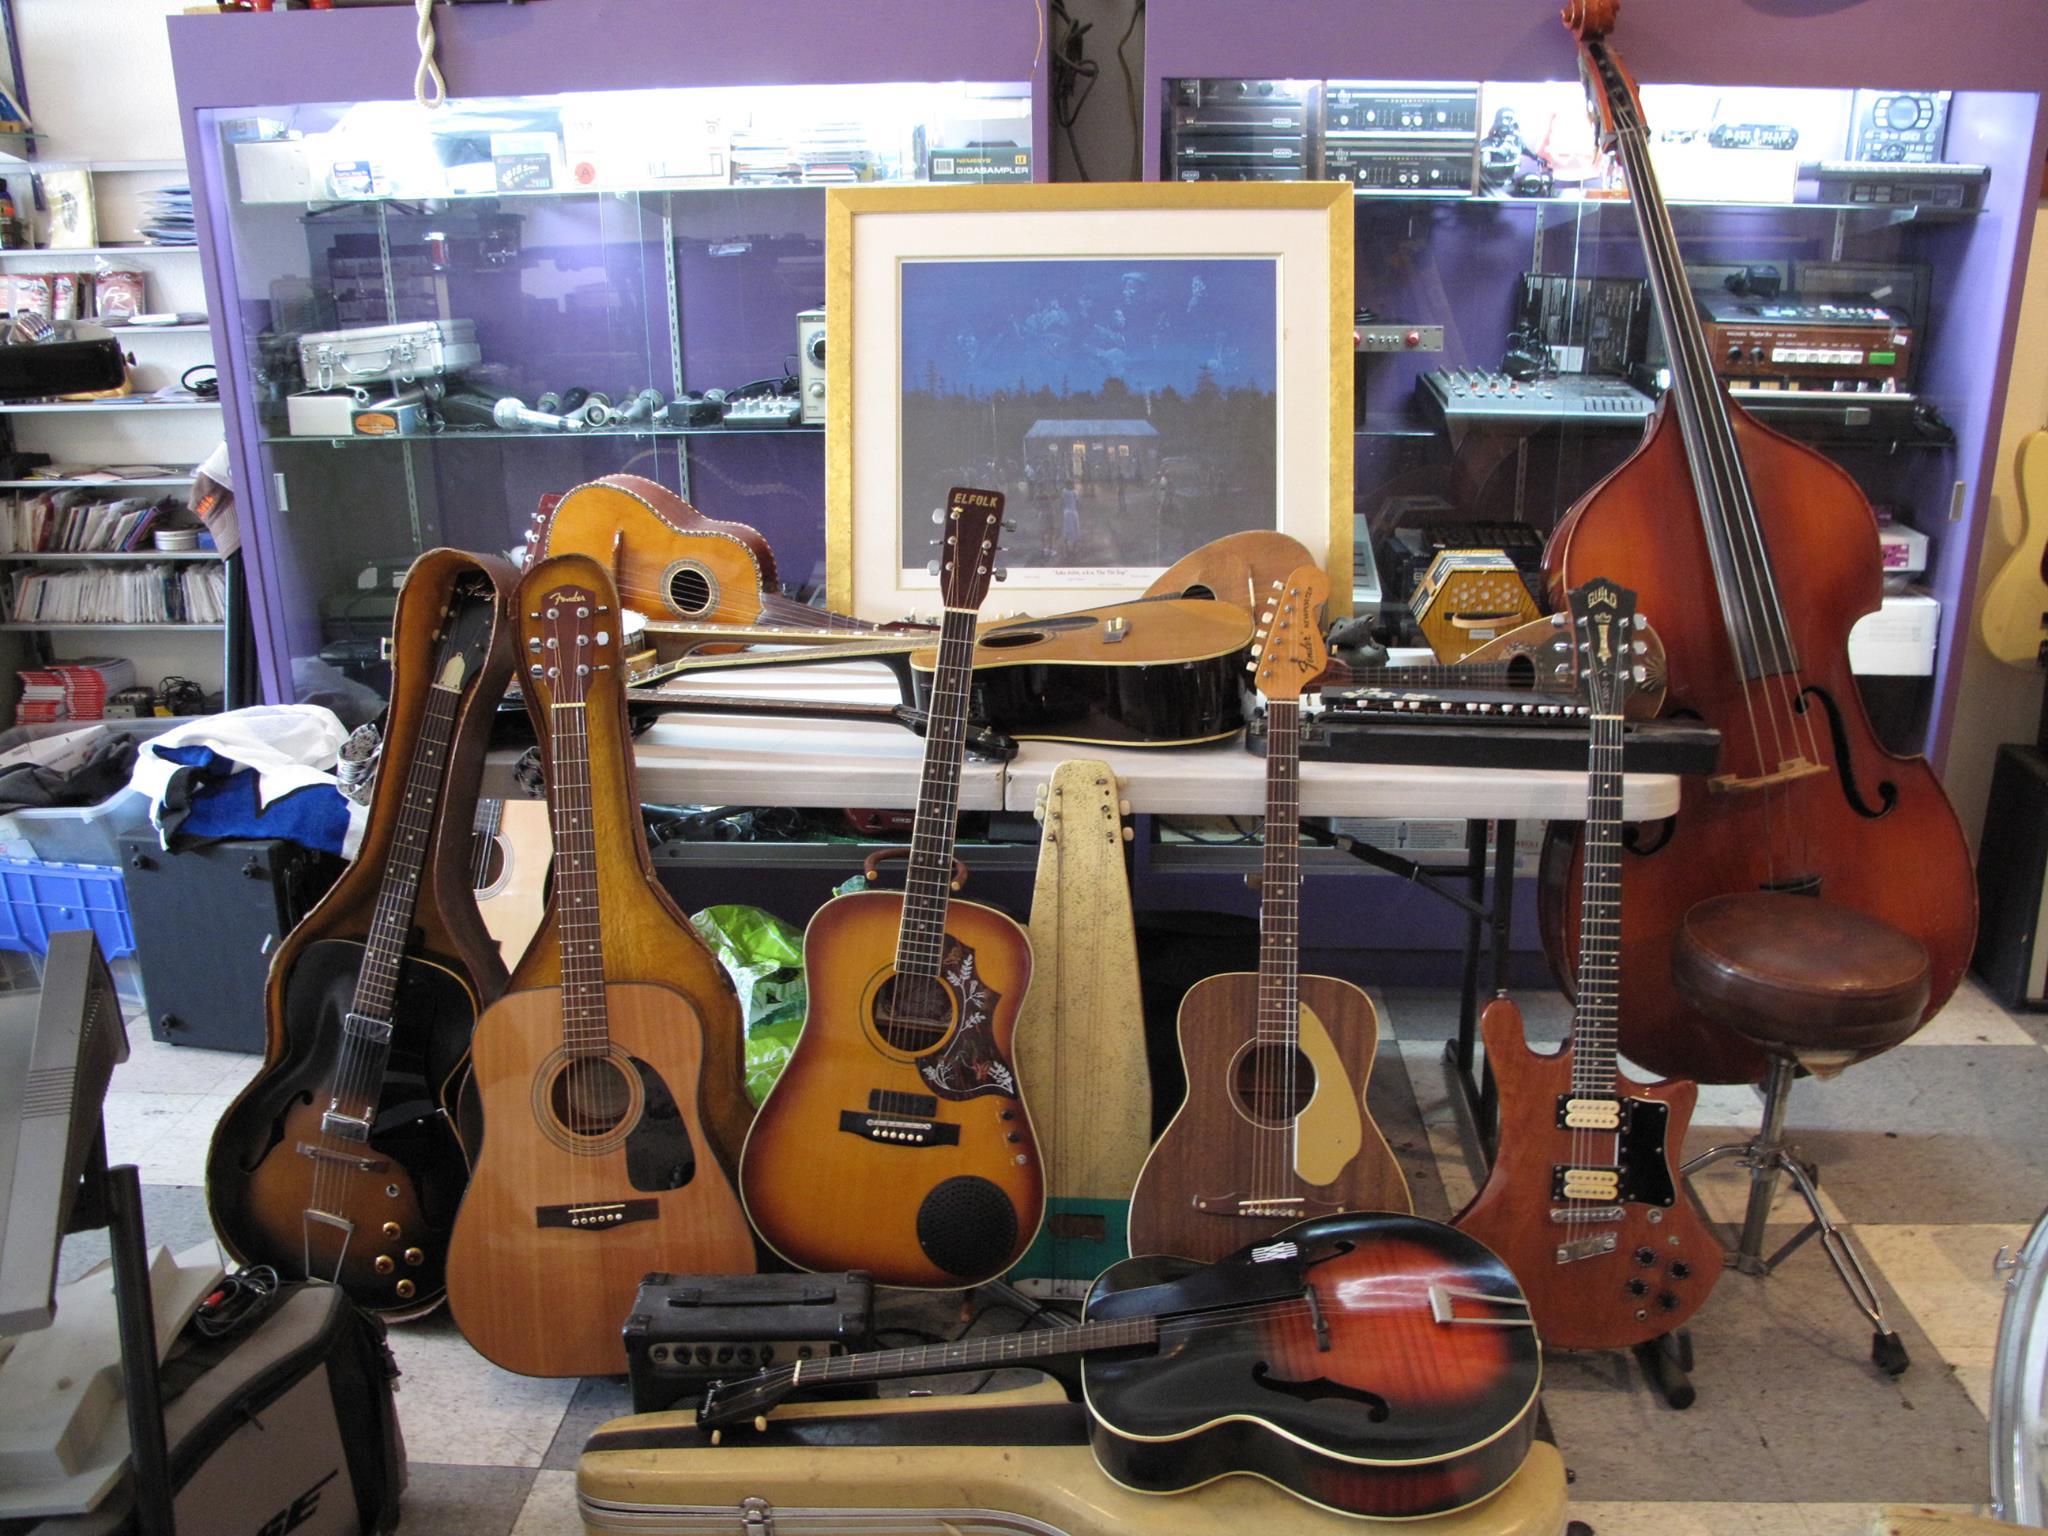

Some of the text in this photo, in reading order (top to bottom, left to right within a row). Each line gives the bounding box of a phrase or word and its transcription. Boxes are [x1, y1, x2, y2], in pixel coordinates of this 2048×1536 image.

[956, 166, 1029, 175] GIGASAMPLER
[953, 492, 998, 508] ELFOLK
[549, 591, 586, 606] Fender
[1587, 586, 1618, 609] GUILD
[1289, 636, 1319, 673] Fender
